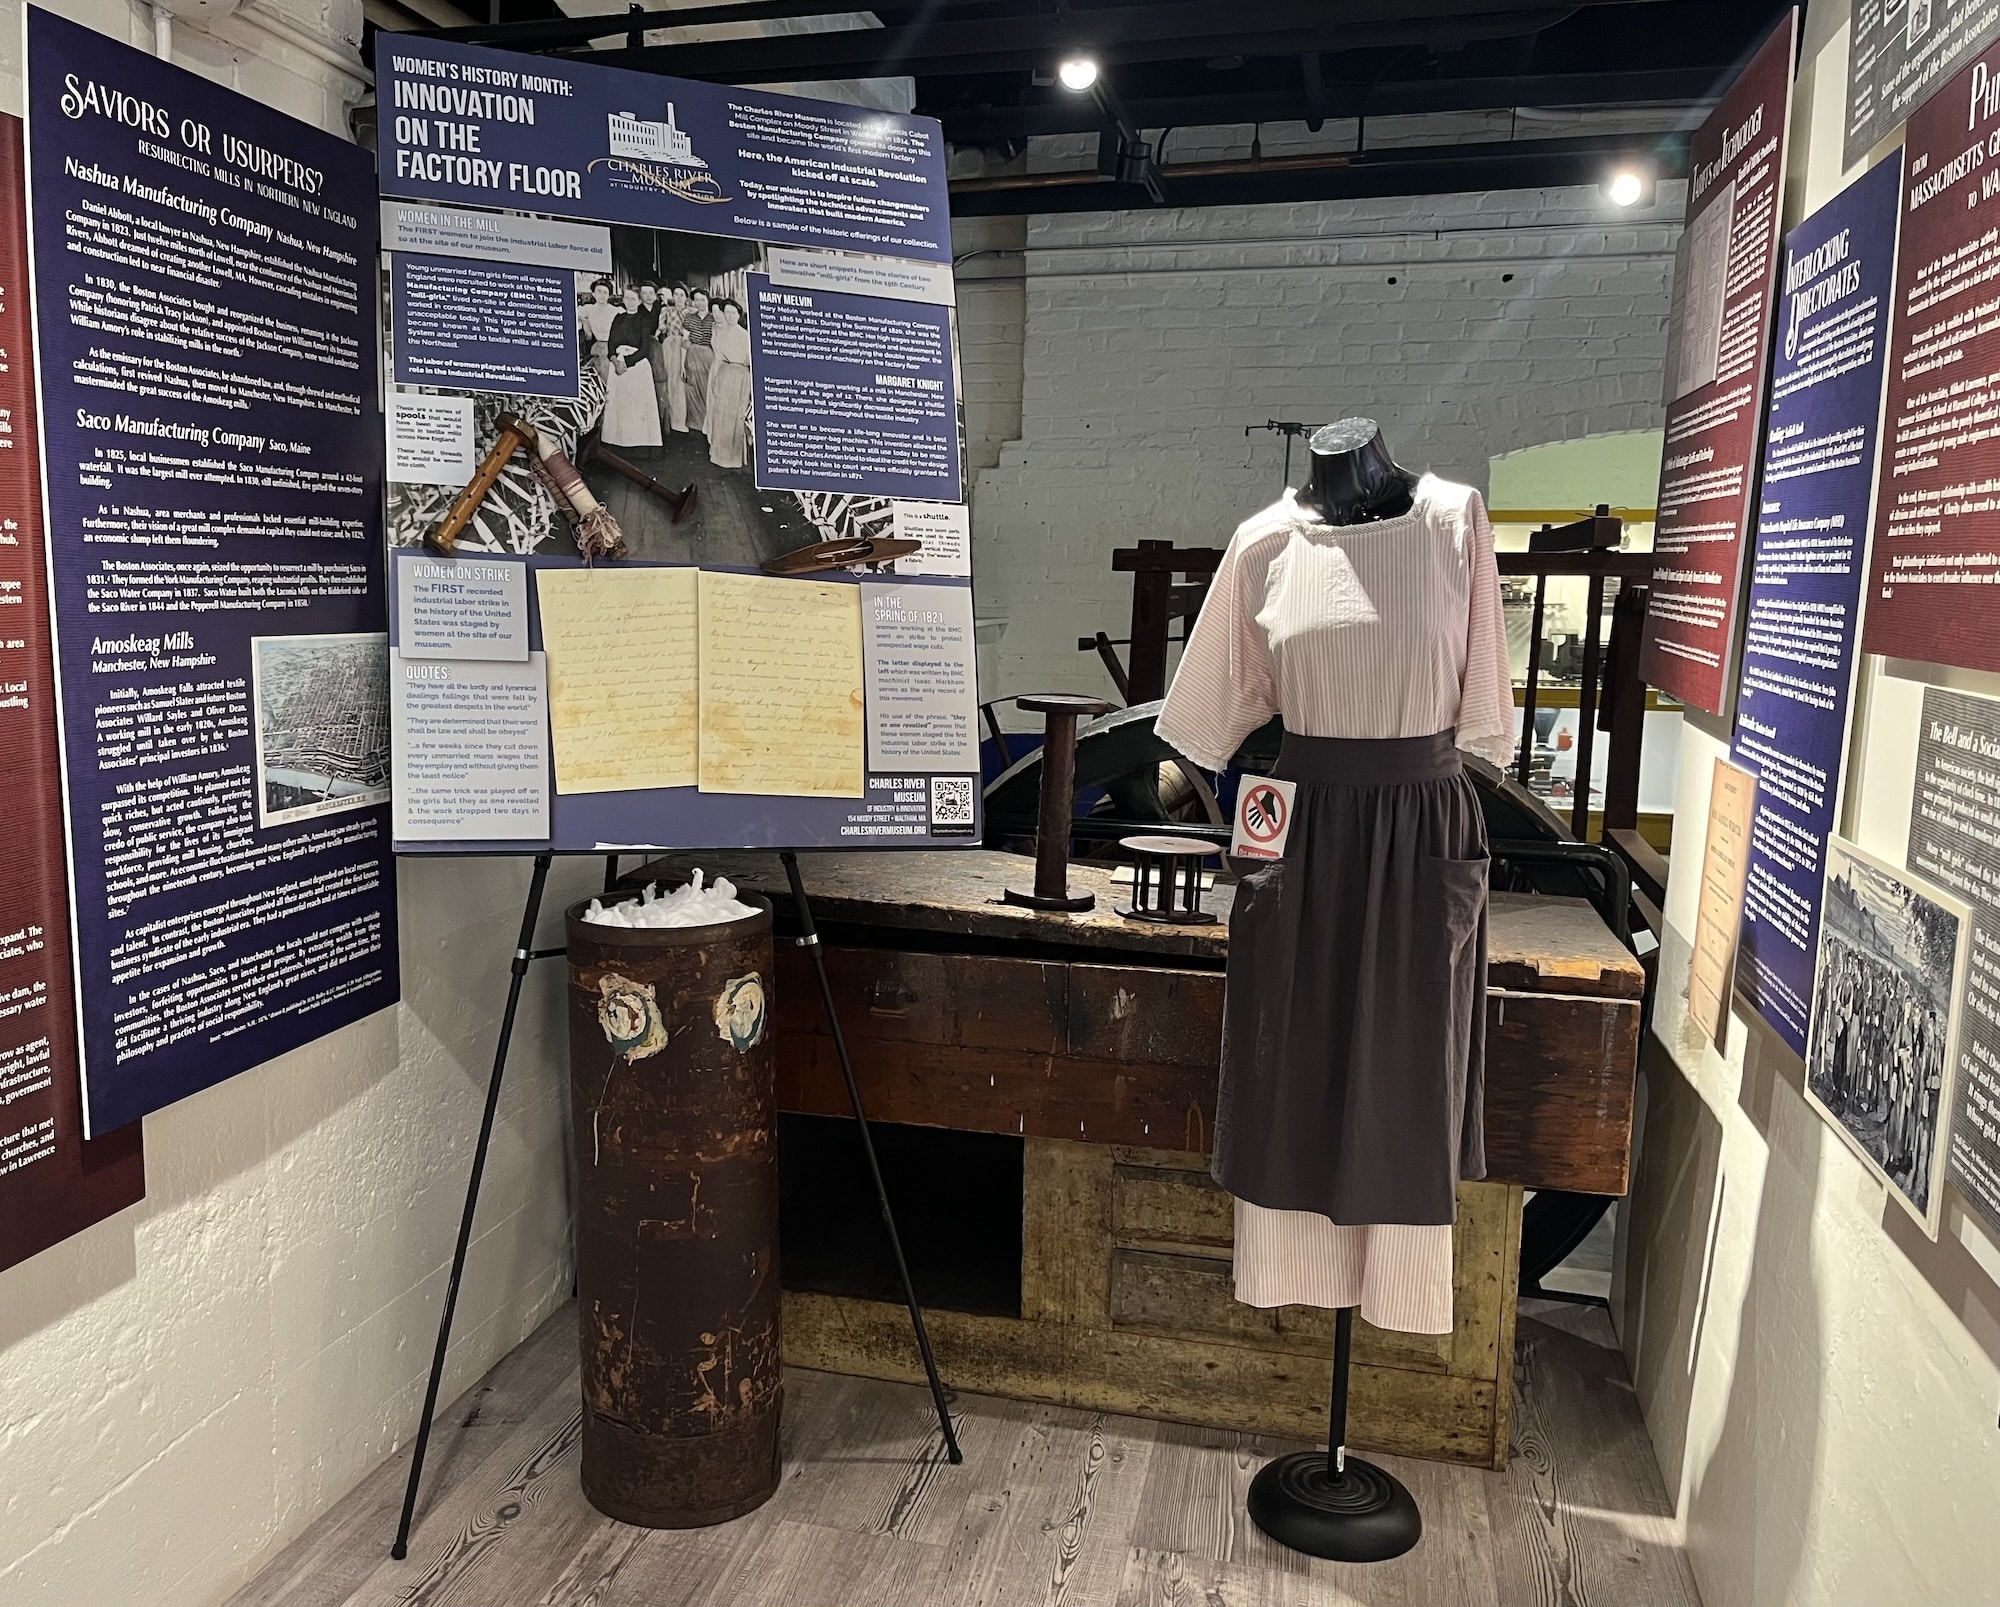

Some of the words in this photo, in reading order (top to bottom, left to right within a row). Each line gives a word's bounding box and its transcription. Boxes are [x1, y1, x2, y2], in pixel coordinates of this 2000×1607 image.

[392, 55, 459, 80] WOMEN'S
[462, 66, 518, 90] HISTORY
[522, 74, 573, 96] MONTH:
[394, 80, 534, 125] INNOVATION
[61, 73, 170, 138] SAVIORS
[181, 119, 211, 155] OR
[223, 134, 323, 196] USURPERS?
[395, 116, 428, 146] ON
[434, 120, 481, 153] THE
[396, 149, 502, 189] FACTORY
[509, 163, 582, 200] FLOOR
[608, 159, 669, 177] CHARLES
[674, 168, 713, 183] RIVER
[738, 149, 765, 162] Here,
[766, 153, 783, 163] the
[784, 156, 830, 169] American
[831, 162, 876, 177] Industrial
[878, 168, 927, 184] Revolution
[138, 139, 210, 177] RESURRECTING
[214, 167, 240, 188] MILLS
[244, 178, 253, 193] IN
[257, 183, 299, 209] NORTHERN
[303, 200, 320, 216] NEW
[323, 207, 357, 230] ENGLAND
[631, 174, 693, 191] MUSEUM
[792, 168, 823, 180] kicked
[825, 173, 838, 182] off
[840, 175, 849, 184] at
[851, 176, 878, 188] scale.
[1910, 141, 1984, 211] MASSACHUSETTS
[621, 184, 658, 192] INDUSTRY
[65, 156, 119, 190] Nashua
[123, 175, 217, 226] Manufacturing
[220, 208, 273, 243] Company
[276, 230, 304, 250] Nashua,
[306, 240, 322, 254] New
[323, 246, 357, 266] Hampshire
[82, 199, 107, 216] Daniel
[108, 207, 134, 225] Abbott,
[141, 216, 158, 230] local
[159, 222, 181, 237] lawyer
[66, 210, 101, 230] Company
[102, 219, 110, 230] in
[111, 222, 131, 237] 1823.
[398, 209, 437, 225] WOMEN
[441, 214, 450, 226] IN
[454, 215, 473, 229] THE
[476, 218, 500, 233] MILL
[415, 227, 437, 235] FIRST
[439, 231, 468, 239] women
[1786, 228, 1850, 296] INTERLOCKING
[85, 273, 93, 284] In
[96, 276, 116, 291] 1830,
[759, 291, 782, 304] MARY
[783, 294, 813, 307] MELVIN
[1785, 260, 1860, 360] DIRECTORATES
[875, 374, 916, 388] MARGARET
[917, 379, 943, 391] KNIGHT
[77, 408, 111, 430] Saco
[115, 414, 209, 448] Manufacturing
[212, 427, 266, 453] Company
[269, 439, 288, 453] Saco,
[289, 442, 311, 454] Maine
[79, 462, 114, 472] waterfall.
[4, 519, 18, 530] the
[413, 564, 454, 579] WOMEN
[457, 567, 472, 580] ON
[474, 568, 511, 581] STRIKE
[431, 584, 464, 594] FIRST
[414, 596, 453, 604] industrial
[874, 596, 883, 608] IN
[885, 597, 901, 608] THE
[430, 608, 457, 617] history
[875, 609, 906, 622] SPRING
[908, 611, 918, 622] OF
[922, 611, 946, 625] 1821,
[7, 639, 24, 648] area
[91, 634, 160, 656] Amoskeag
[164, 631, 194, 650] Mills
[92, 658, 148, 673] Manchester,
[150, 657, 170, 670] New
[172, 653, 216, 669] Hampshire
[406, 665, 451, 680] QUOTES:
[6, 681, 27, 693] Local
[1930, 721, 1942, 741] The
[1943, 725, 1958, 745] Bell
[1957, 730, 1974, 750] and
[1972, 738, 1978, 752] a
[869, 778, 903, 789] CHARLES
[904, 779, 926, 789] RIVER
[894, 792, 926, 802] MUSEUM
[102, 812, 122, 826] quick
[125, 809, 149, 820] riches,
[151, 806, 163, 816] but
[166, 802, 184, 812] acted
[840, 826, 926, 835] CHARLESRIVERMUSEUM.ORG
[28, 925, 43, 937] The
[12, 986, 32, 999] dam,
[24, 995, 47, 1010] water
[25, 1036, 50, 1052] agent,
[26, 1049, 50, 1065] lawful
[6, 1077, 52, 1105] government
